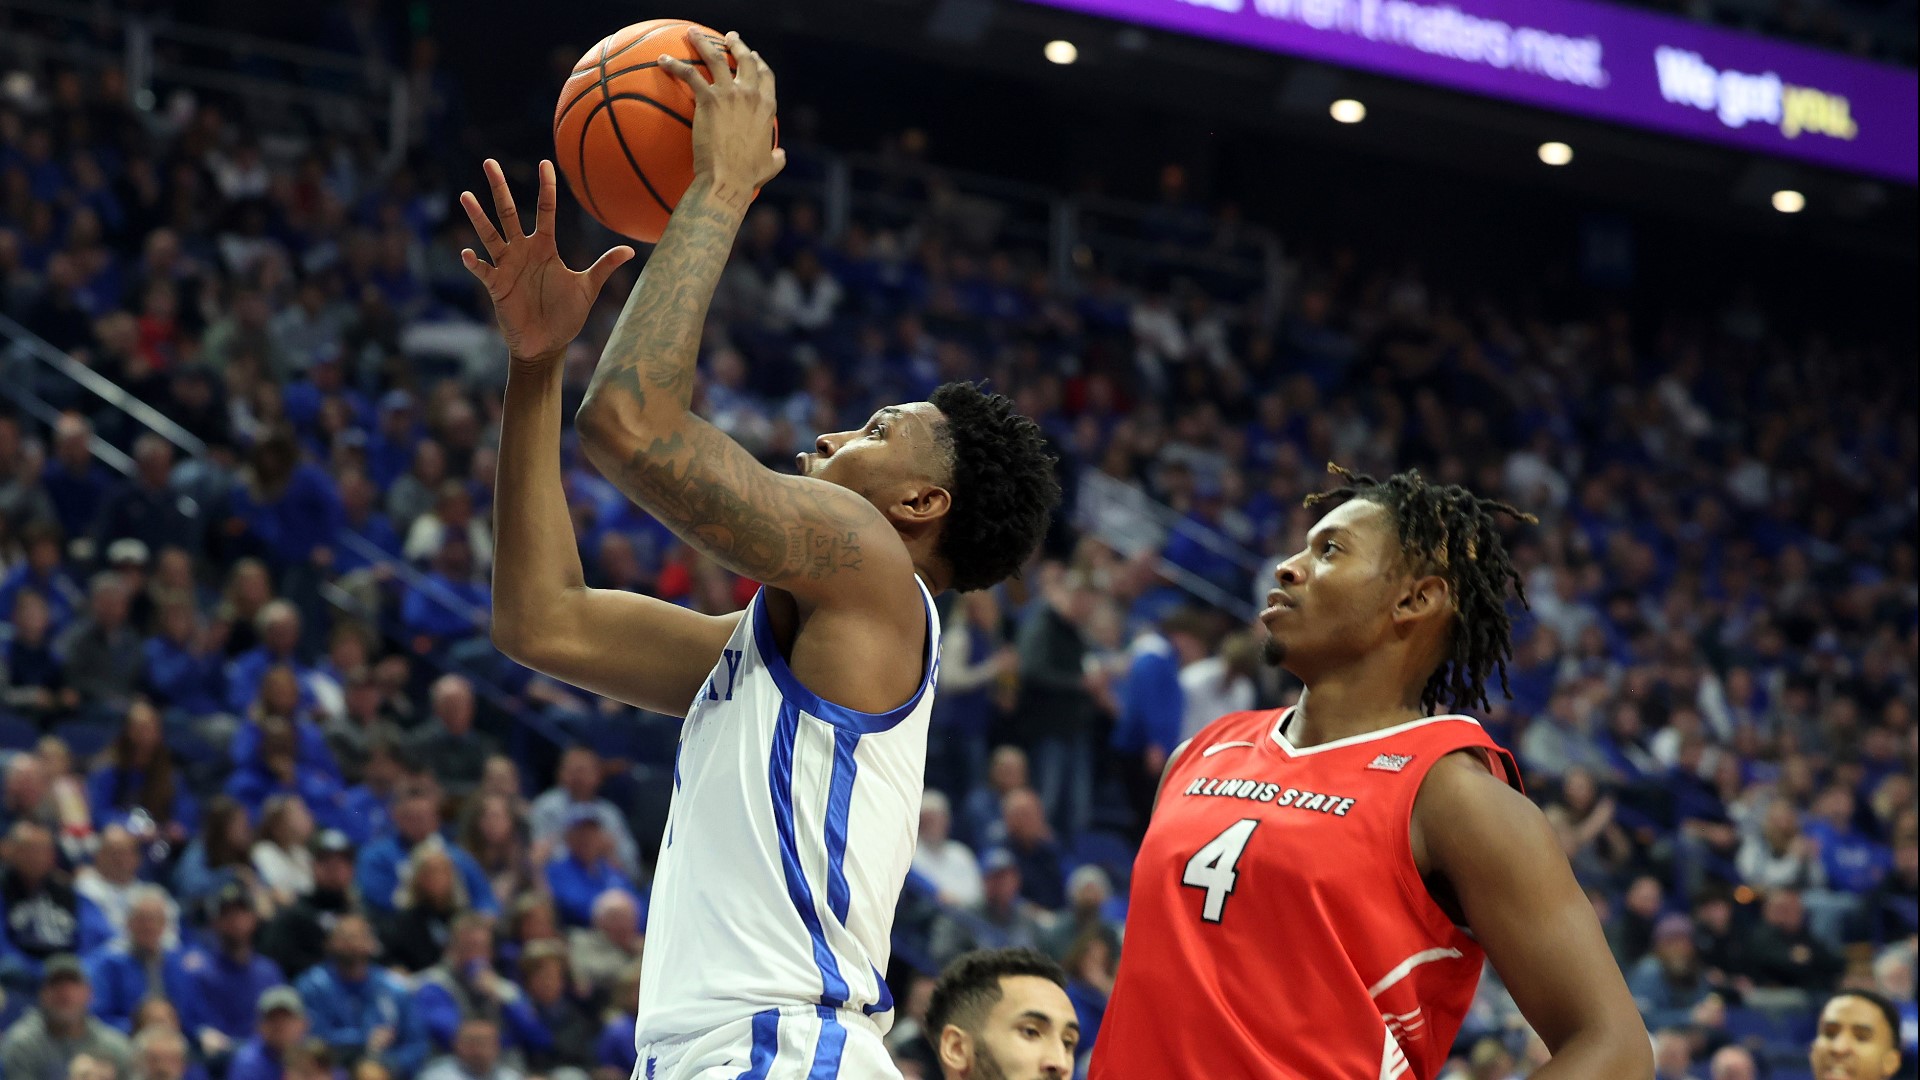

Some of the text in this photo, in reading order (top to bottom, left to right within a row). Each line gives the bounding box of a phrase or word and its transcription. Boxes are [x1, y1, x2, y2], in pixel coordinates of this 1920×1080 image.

[1654, 45, 1858, 141] We got you.
[1184, 778, 1356, 816] ILLINOIS STATE
[1181, 818, 1261, 924] 4
